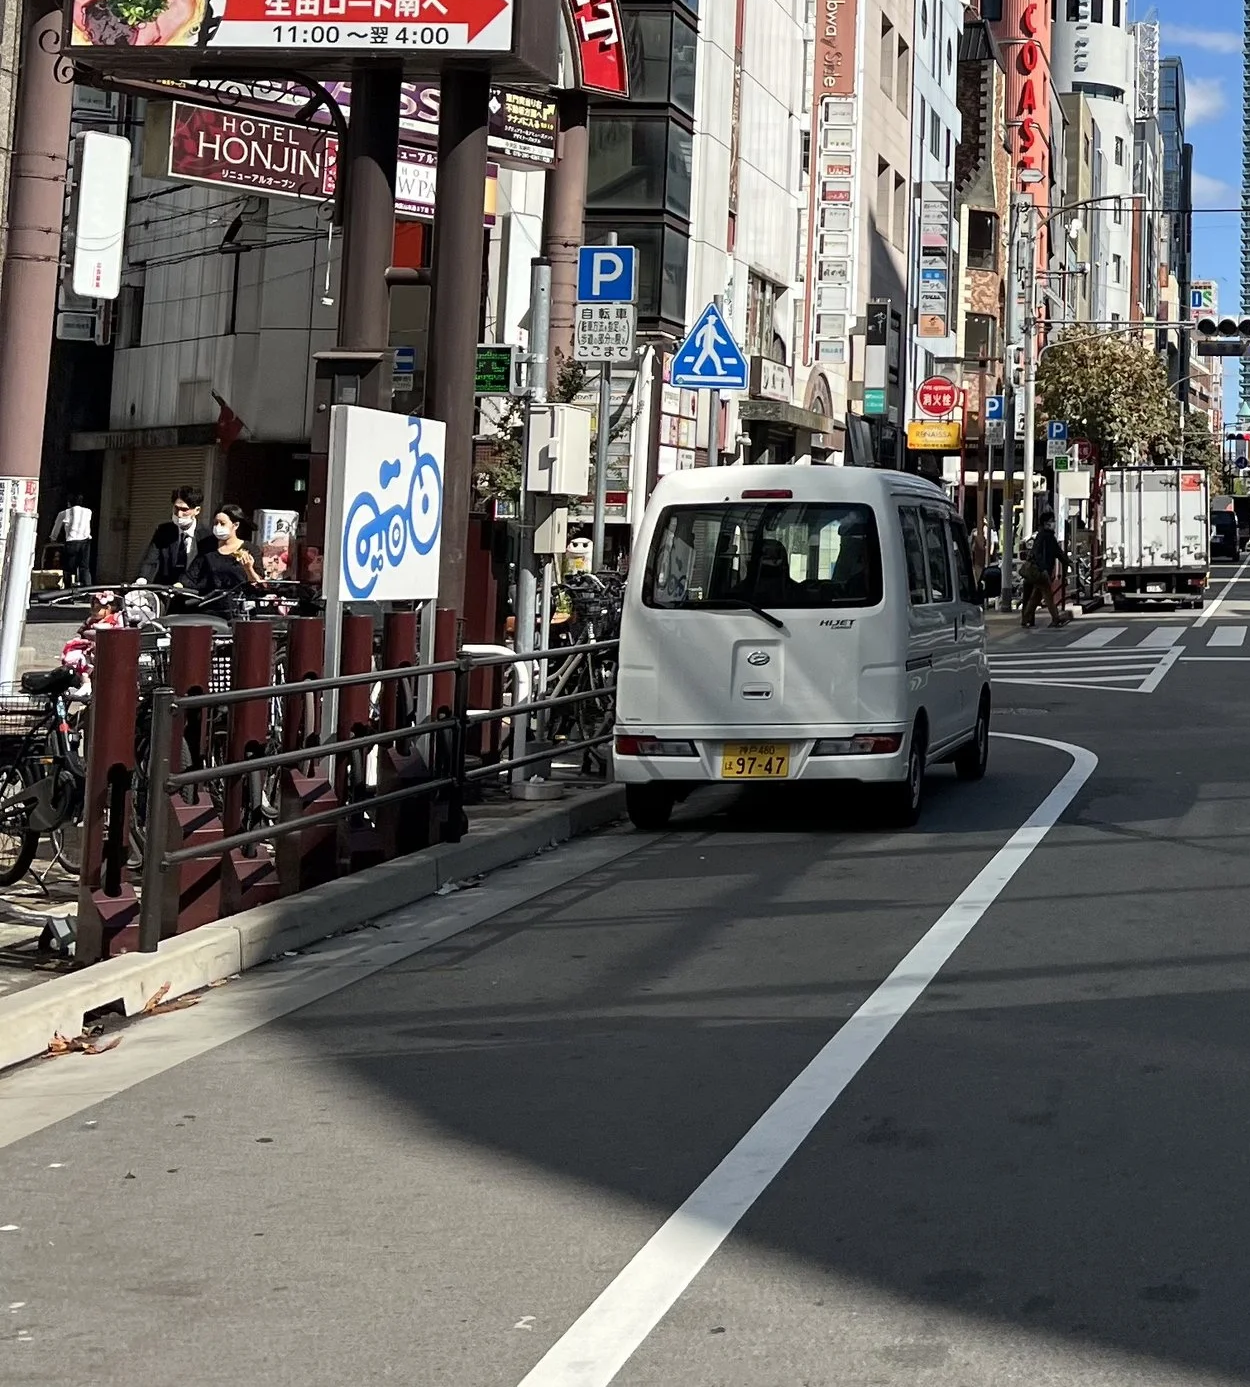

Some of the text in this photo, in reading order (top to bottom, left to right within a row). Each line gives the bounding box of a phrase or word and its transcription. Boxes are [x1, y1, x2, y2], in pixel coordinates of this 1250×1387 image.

[272, 25, 341, 44] 11:00
[394, 26, 450, 45] 4:00
[222, 116, 300, 146] HOTEL
[197, 130, 321, 179] HONJIN
[221, 168, 296, 189] リニューアルオープン
[592, 252, 624, 296] P
[581, 307, 628, 320] 自転車
[578, 345, 629, 358] ここまで
[922, 393, 952, 407] 消火栓
[986, 397, 999, 418] P
[1053, 424, 1064, 436] P
[820, 618, 856, 626] HIJET
[735, 756, 785, 775] 97-47
